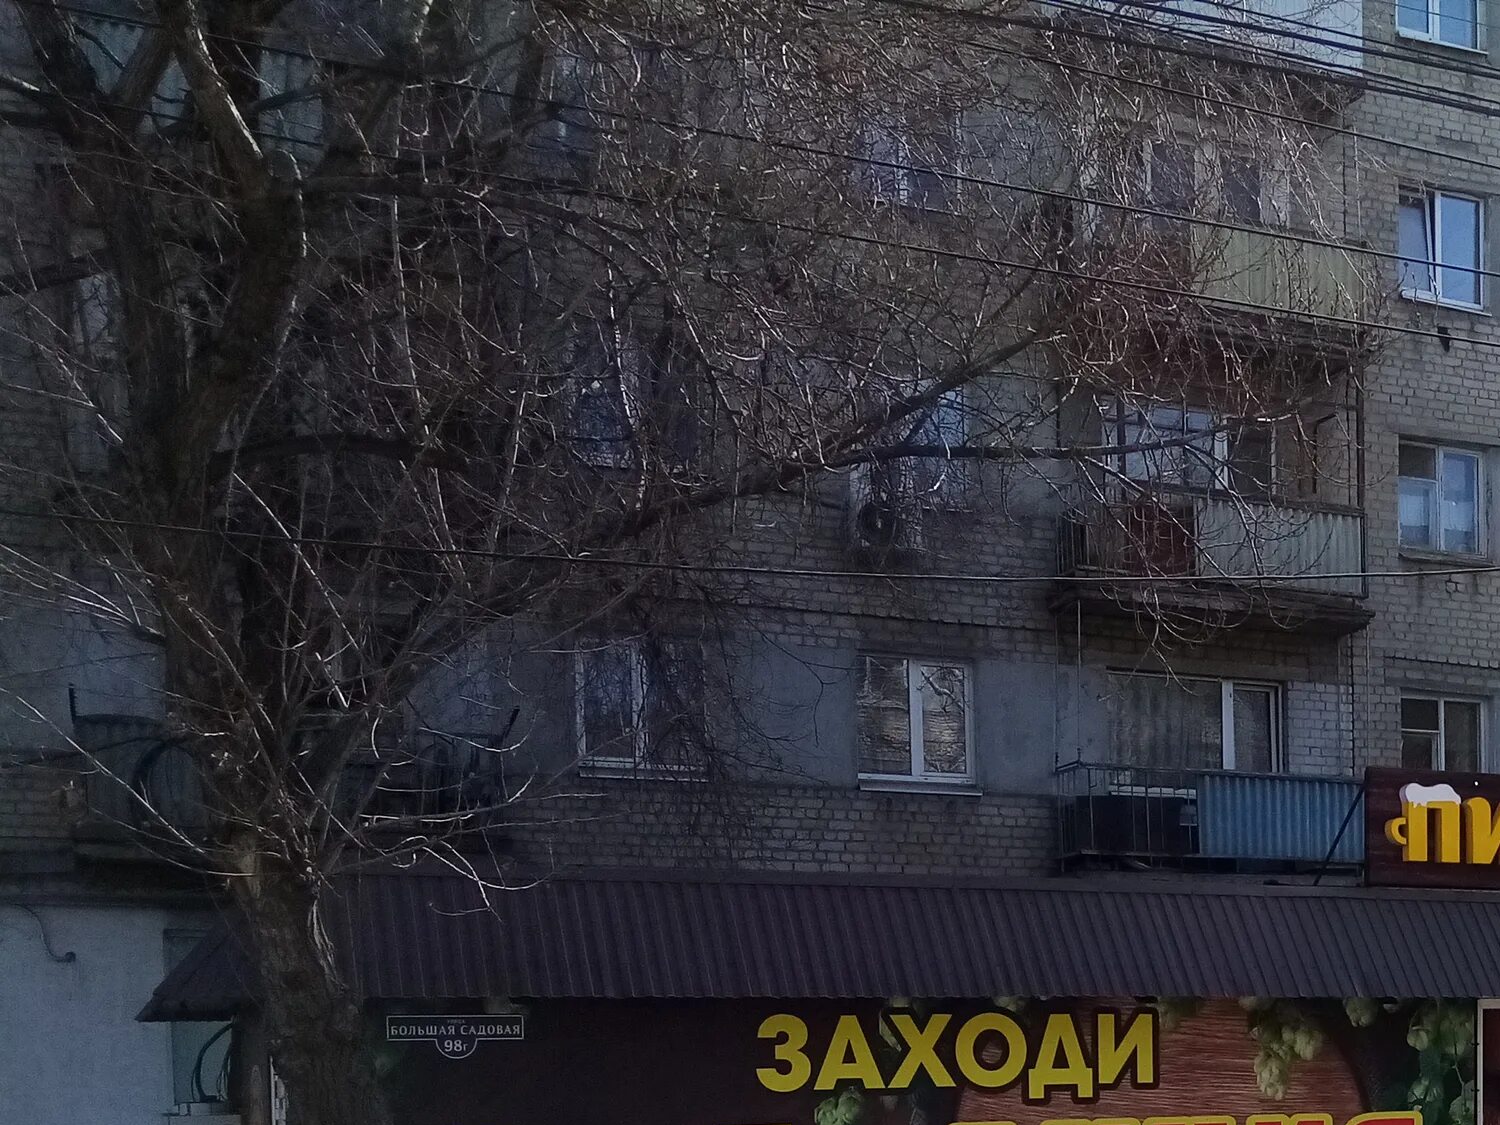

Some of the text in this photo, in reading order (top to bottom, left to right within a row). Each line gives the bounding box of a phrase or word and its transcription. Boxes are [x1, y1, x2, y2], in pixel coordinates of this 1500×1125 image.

[391, 1024, 520, 1036] БОЛЬШАЯ САДОВАЯ
[756, 1012, 1155, 1099] ЗАХОДИ
